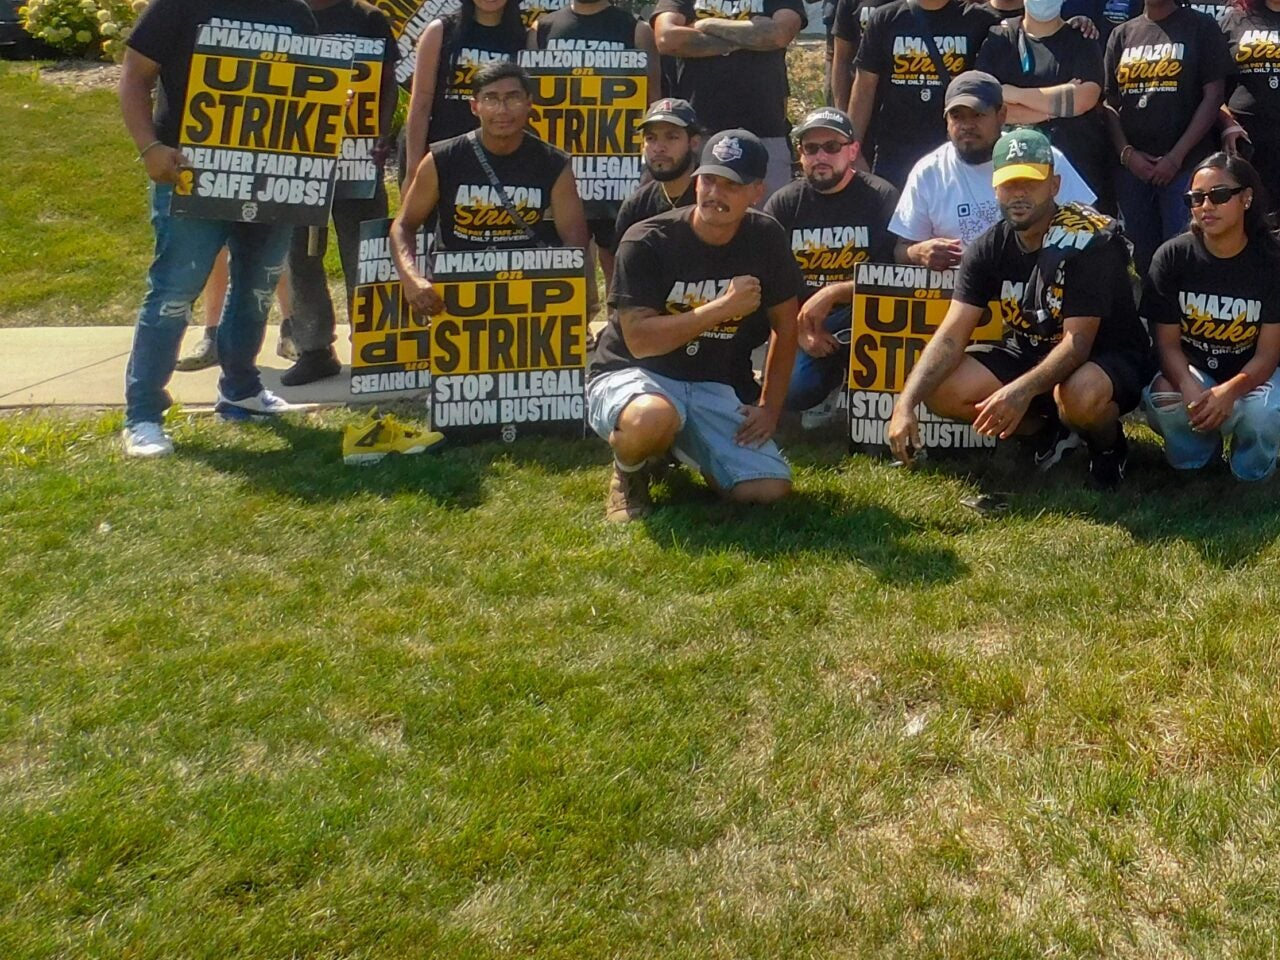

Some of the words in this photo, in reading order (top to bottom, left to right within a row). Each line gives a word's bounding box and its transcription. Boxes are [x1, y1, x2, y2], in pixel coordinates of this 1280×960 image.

[198, 27, 277, 52] AMAZON
[278, 35, 353, 60] DRIVERS
[260, 52, 288, 61] on
[1120, 43, 1184, 64] AMAZON
[521, 51, 584, 68] AMAZON
[584, 51, 647, 68] DRIVERS
[203, 58, 338, 98] ULP
[532, 78, 638, 106] ULP
[186, 92, 342, 154] STRIKE
[529, 108, 643, 154] STRIKE
[182, 148, 253, 173] DELIVER
[255, 155, 297, 176] FAIR
[299, 158, 336, 179] PAY
[572, 157, 641, 178] ILLEGAL
[176, 170, 193, 195] &
[198, 172, 254, 200] SAFE
[257, 178, 328, 206] JOBS!
[792, 226, 868, 250] AMAZON
[434, 252, 510, 274] AMAZON
[512, 250, 583, 270] DRIVERS
[793, 242, 869, 269] Strike
[496, 271, 523, 280] on
[857, 265, 927, 288] AMAZON
[444, 280, 575, 317] ULP
[667, 279, 732, 304] AMAZ
[434, 315, 582, 372] STRIKE
[436, 374, 493, 402] STOP
[499, 370, 583, 397] ILLEGAL
[435, 400, 497, 427] UNION
[500, 396, 583, 422] BUSTING
